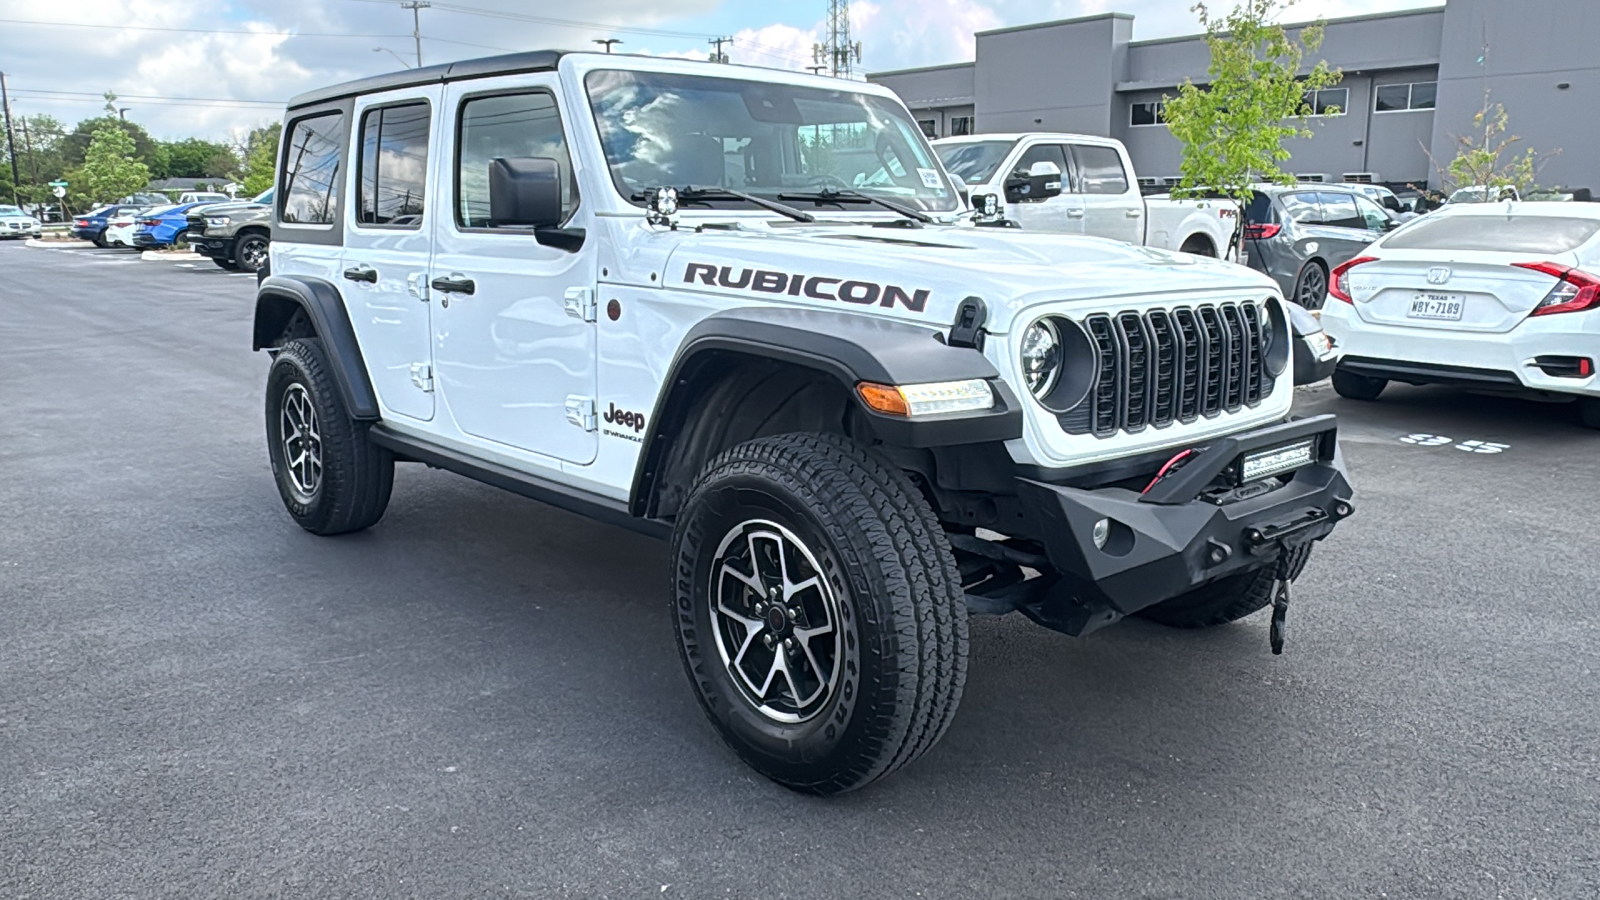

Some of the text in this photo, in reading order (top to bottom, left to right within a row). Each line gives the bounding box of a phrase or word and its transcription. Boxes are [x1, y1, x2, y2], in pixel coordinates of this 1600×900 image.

[683, 262, 931, 313] RUBICON
[603, 402, 645, 433] Jeep
[609, 430, 643, 443] WRANGLE
